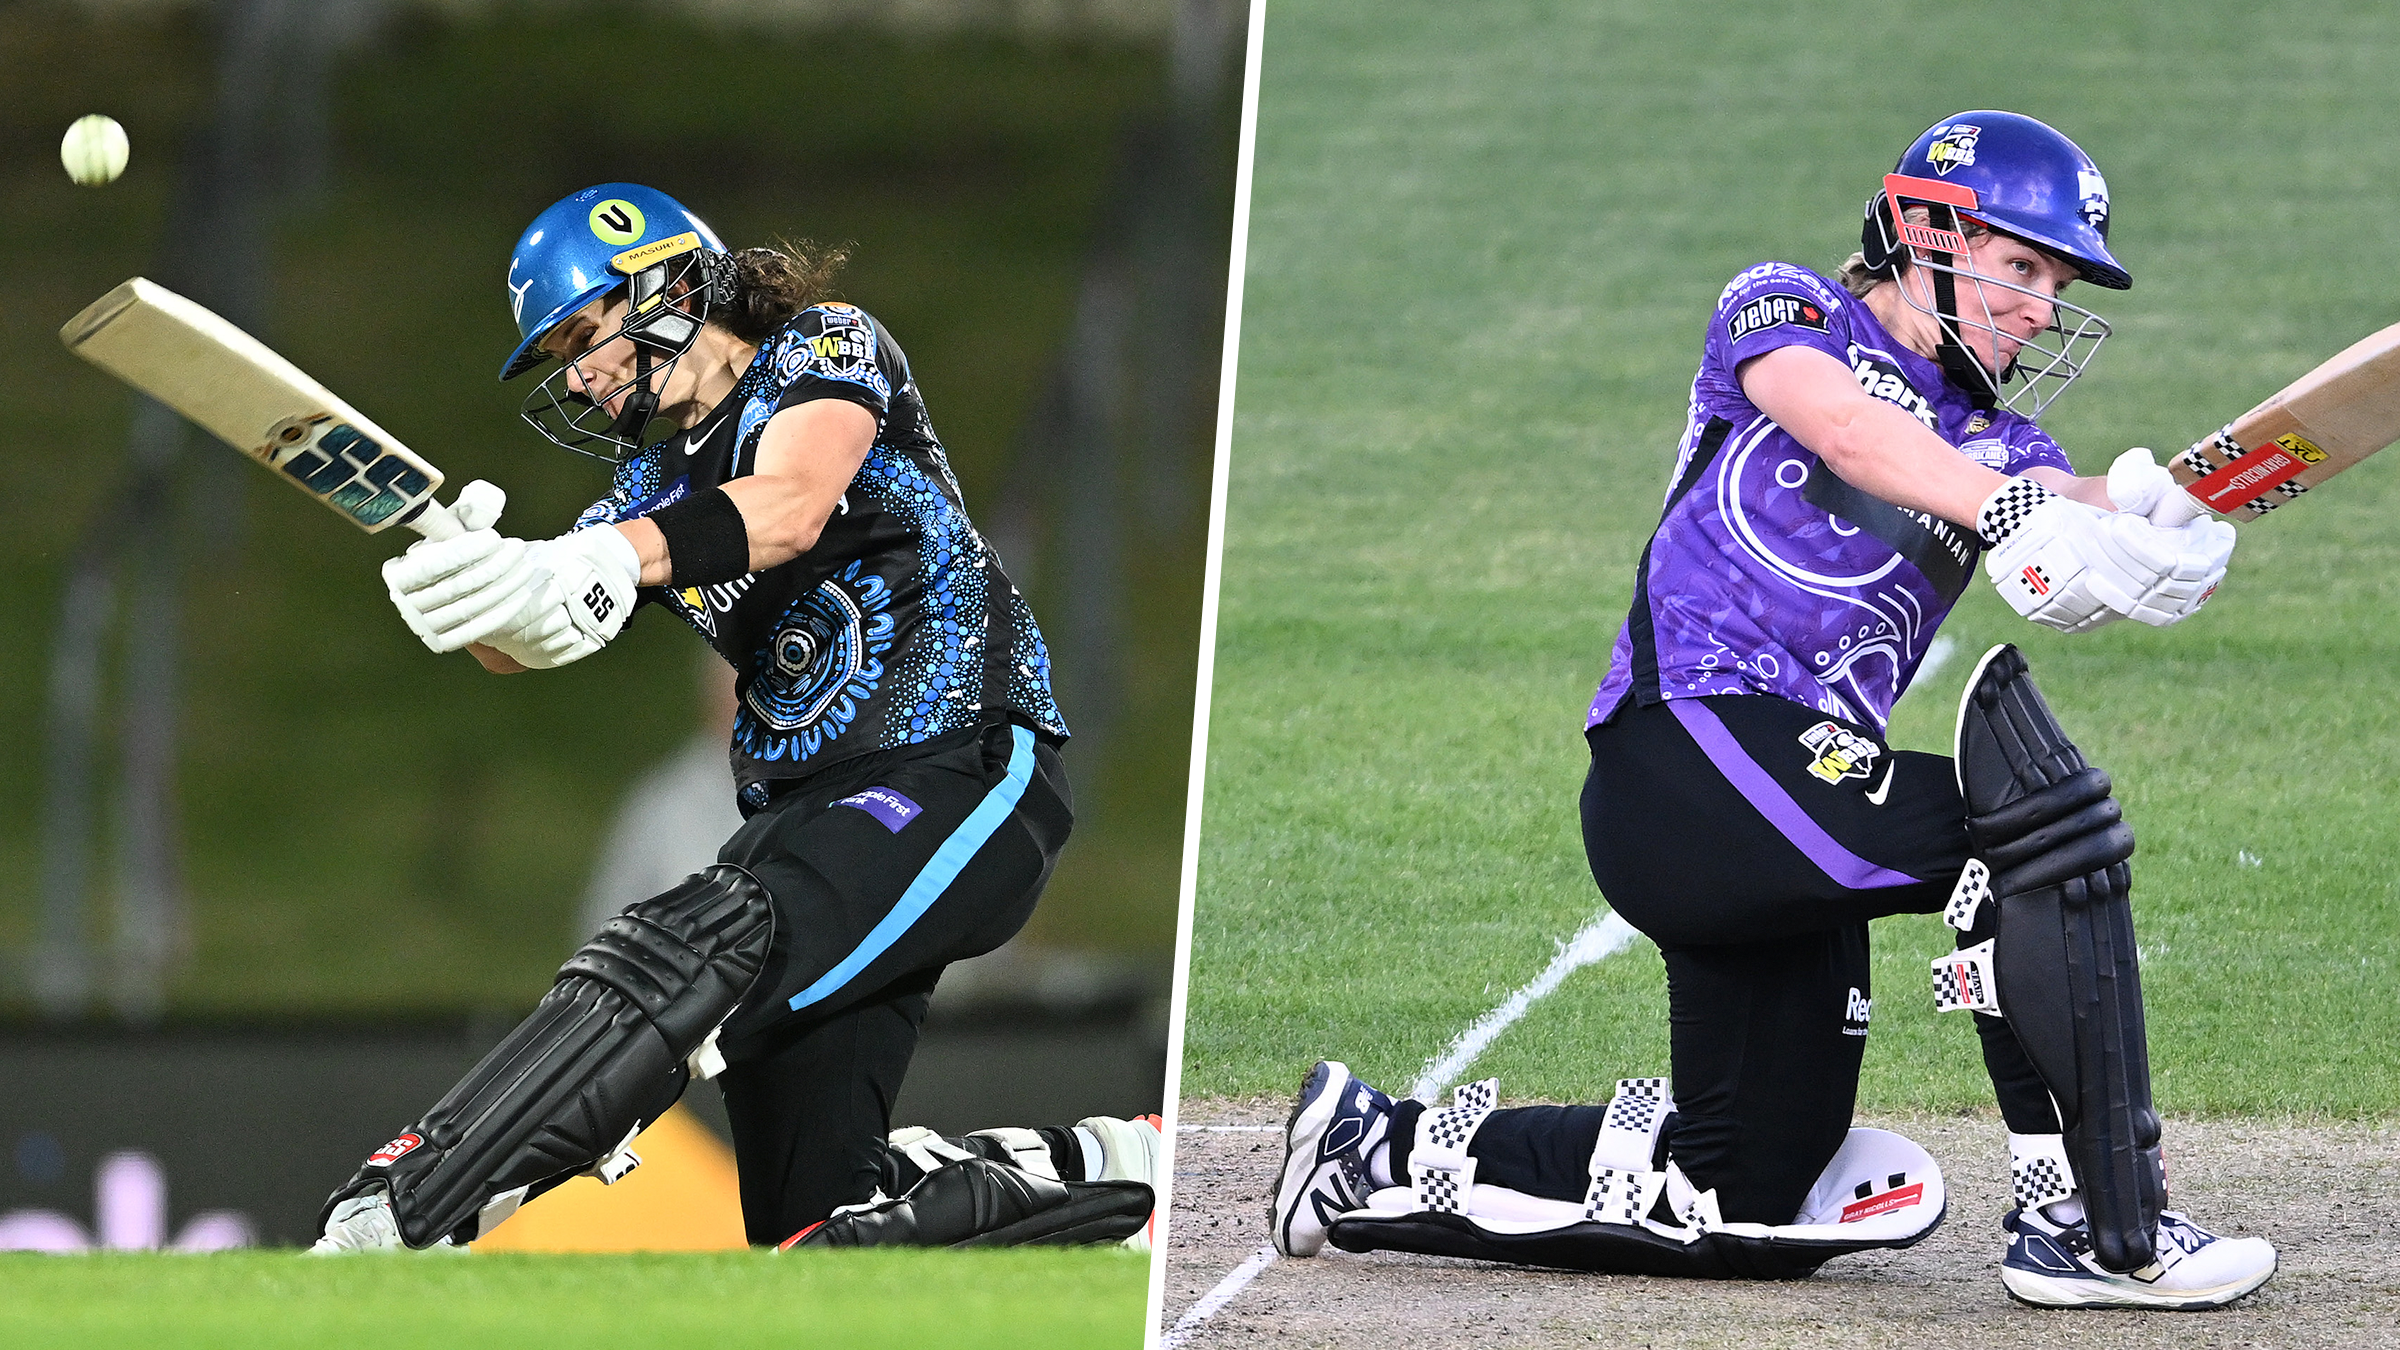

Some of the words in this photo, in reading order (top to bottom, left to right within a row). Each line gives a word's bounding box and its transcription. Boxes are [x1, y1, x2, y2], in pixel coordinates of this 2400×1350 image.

[628, 241, 675, 260] MASURI
[582, 581, 615, 623] SS
[883, 795, 911, 817] First
